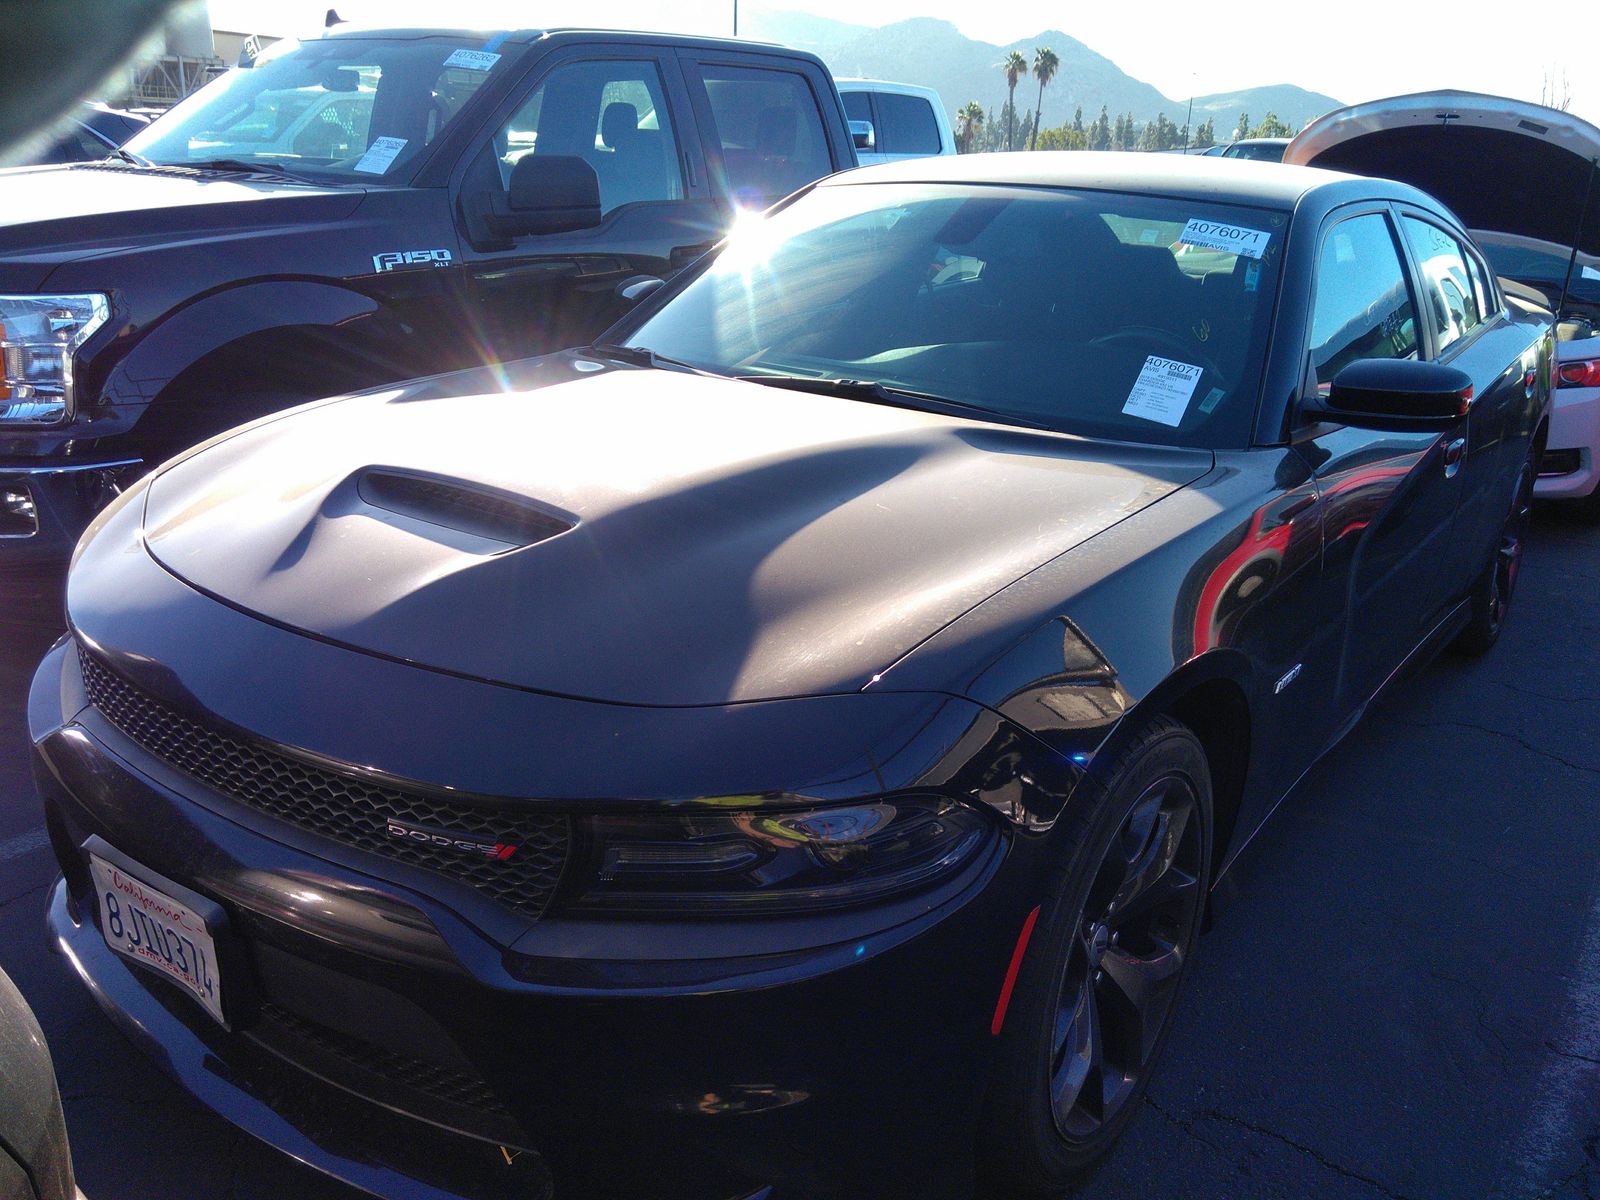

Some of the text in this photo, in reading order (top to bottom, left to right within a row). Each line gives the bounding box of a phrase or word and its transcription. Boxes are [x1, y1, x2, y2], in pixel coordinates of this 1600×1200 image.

[1188, 222, 1260, 243] 4076071
[1209, 243, 1230, 252] AVIS
[1143, 365, 1160, 374] AVIS
[1145, 357, 1201, 377] 4076071
[388, 824, 499, 855] DODGE
[112, 871, 181, 920] California
[105, 891, 214, 1000] 8JIU374
